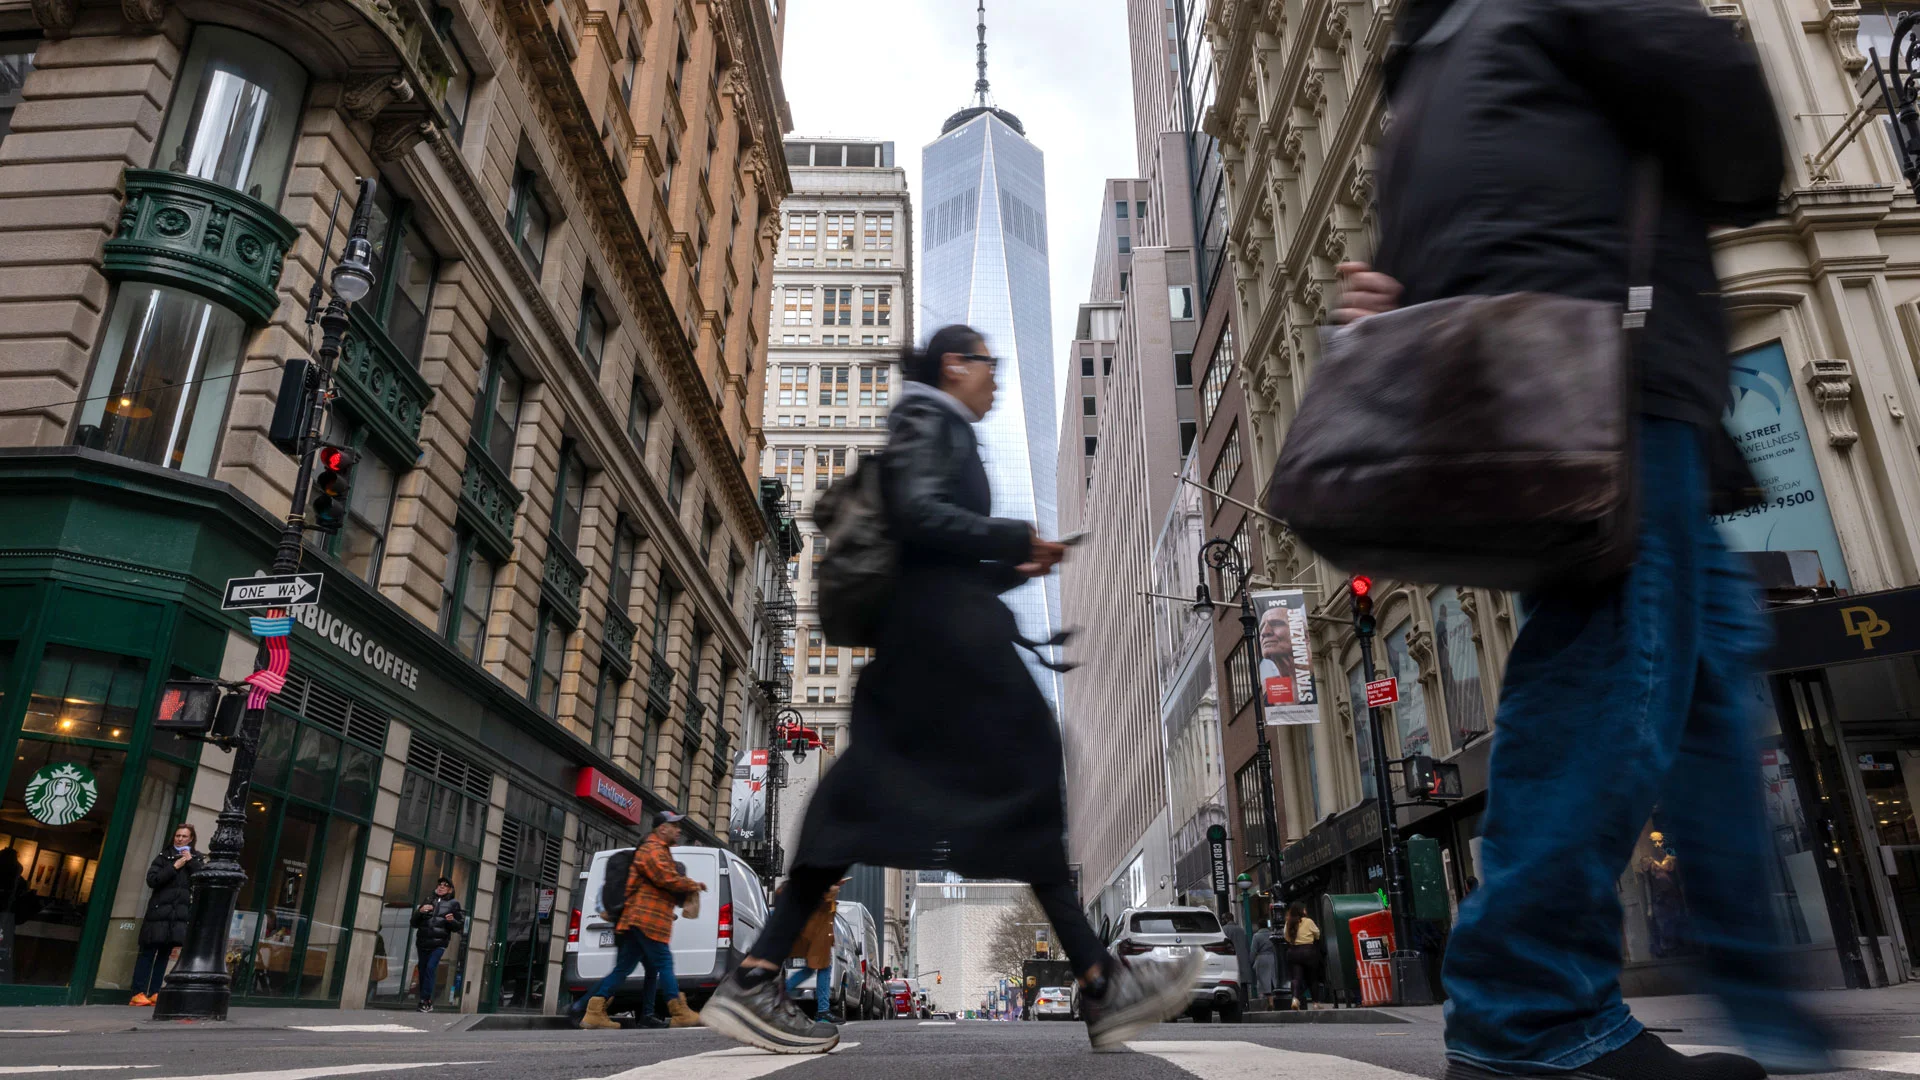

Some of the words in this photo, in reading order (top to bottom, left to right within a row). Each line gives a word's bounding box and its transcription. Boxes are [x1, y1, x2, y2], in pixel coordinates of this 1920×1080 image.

[1746, 423, 1781, 441] STREET
[1743, 431, 1800, 454] WELLNESS
[1760, 476, 1780, 487] OUR
[1772, 479, 1801, 493] TODAY
[239, 585, 267, 599] ONE
[278, 583, 306, 597] WAY
[1269, 599, 1287, 607] NYC
[1286, 608, 1310, 666] AMAZING
[287, 604, 363, 657] RBUCKS
[363, 639, 419, 691] COFFEE
[1294, 668, 1314, 702] STAY
[740, 828, 754, 839] bgc
[1362, 810, 1379, 839] 139
[1212, 843, 1223, 859] CBD
[1214, 860, 1226, 891] KRATOM
